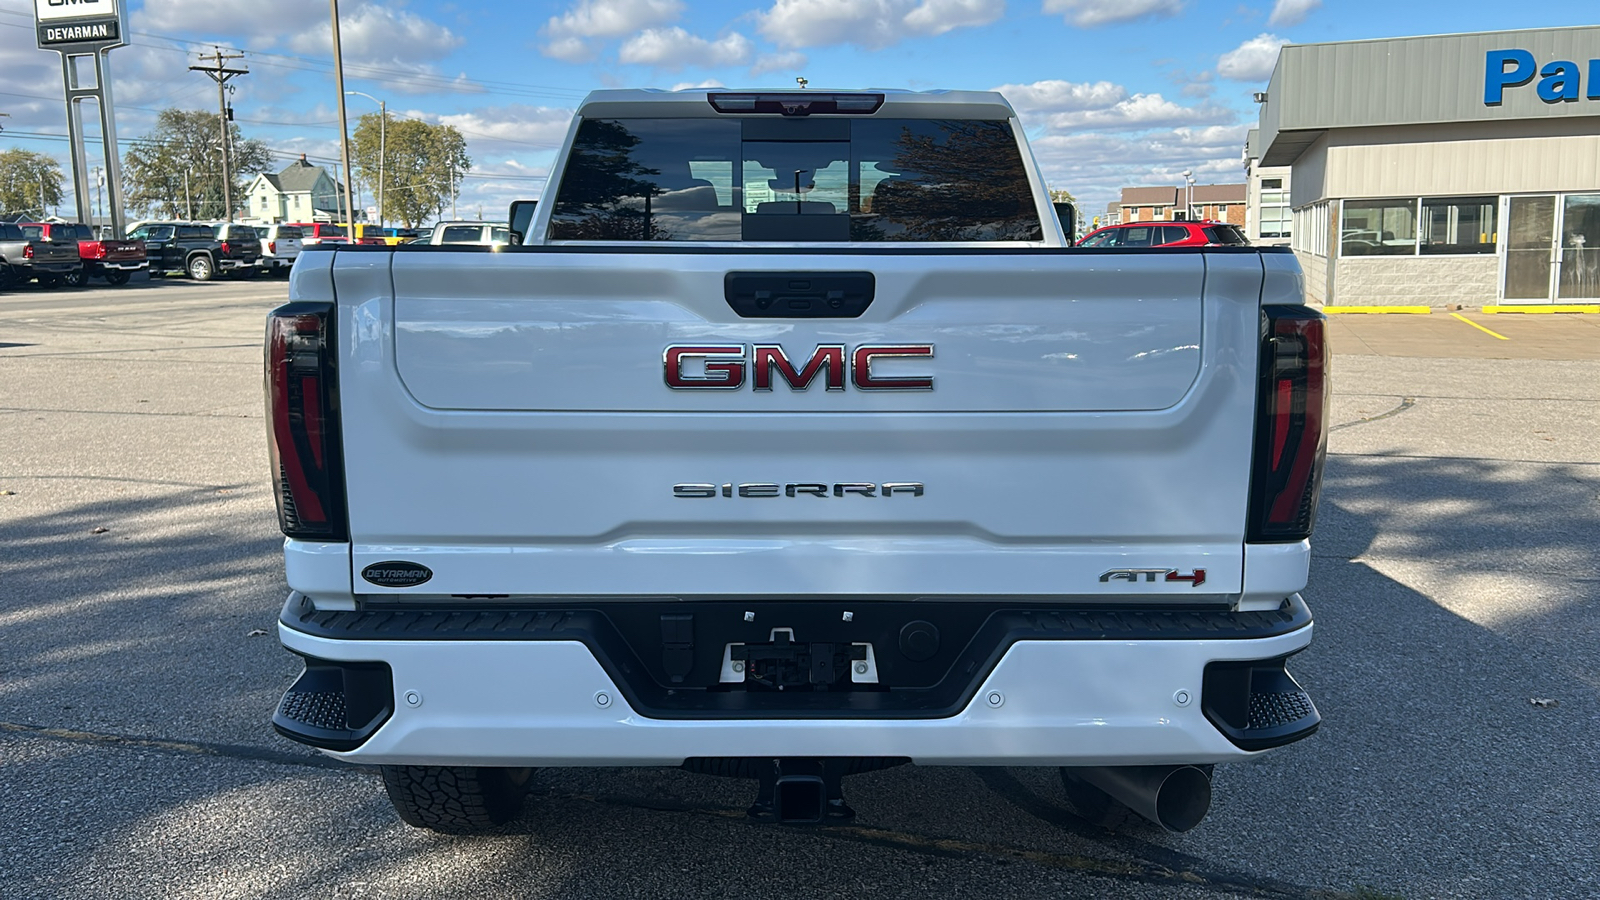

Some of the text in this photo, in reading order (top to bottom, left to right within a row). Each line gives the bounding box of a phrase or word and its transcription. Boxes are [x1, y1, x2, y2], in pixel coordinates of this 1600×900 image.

[47, 24, 107, 40] DEYARMAN
[663, 343, 935, 392] GMC
[673, 482, 924, 498] SIERRA
[366, 569, 429, 578] DEYARMAN
[1099, 568, 1206, 587] AT4
